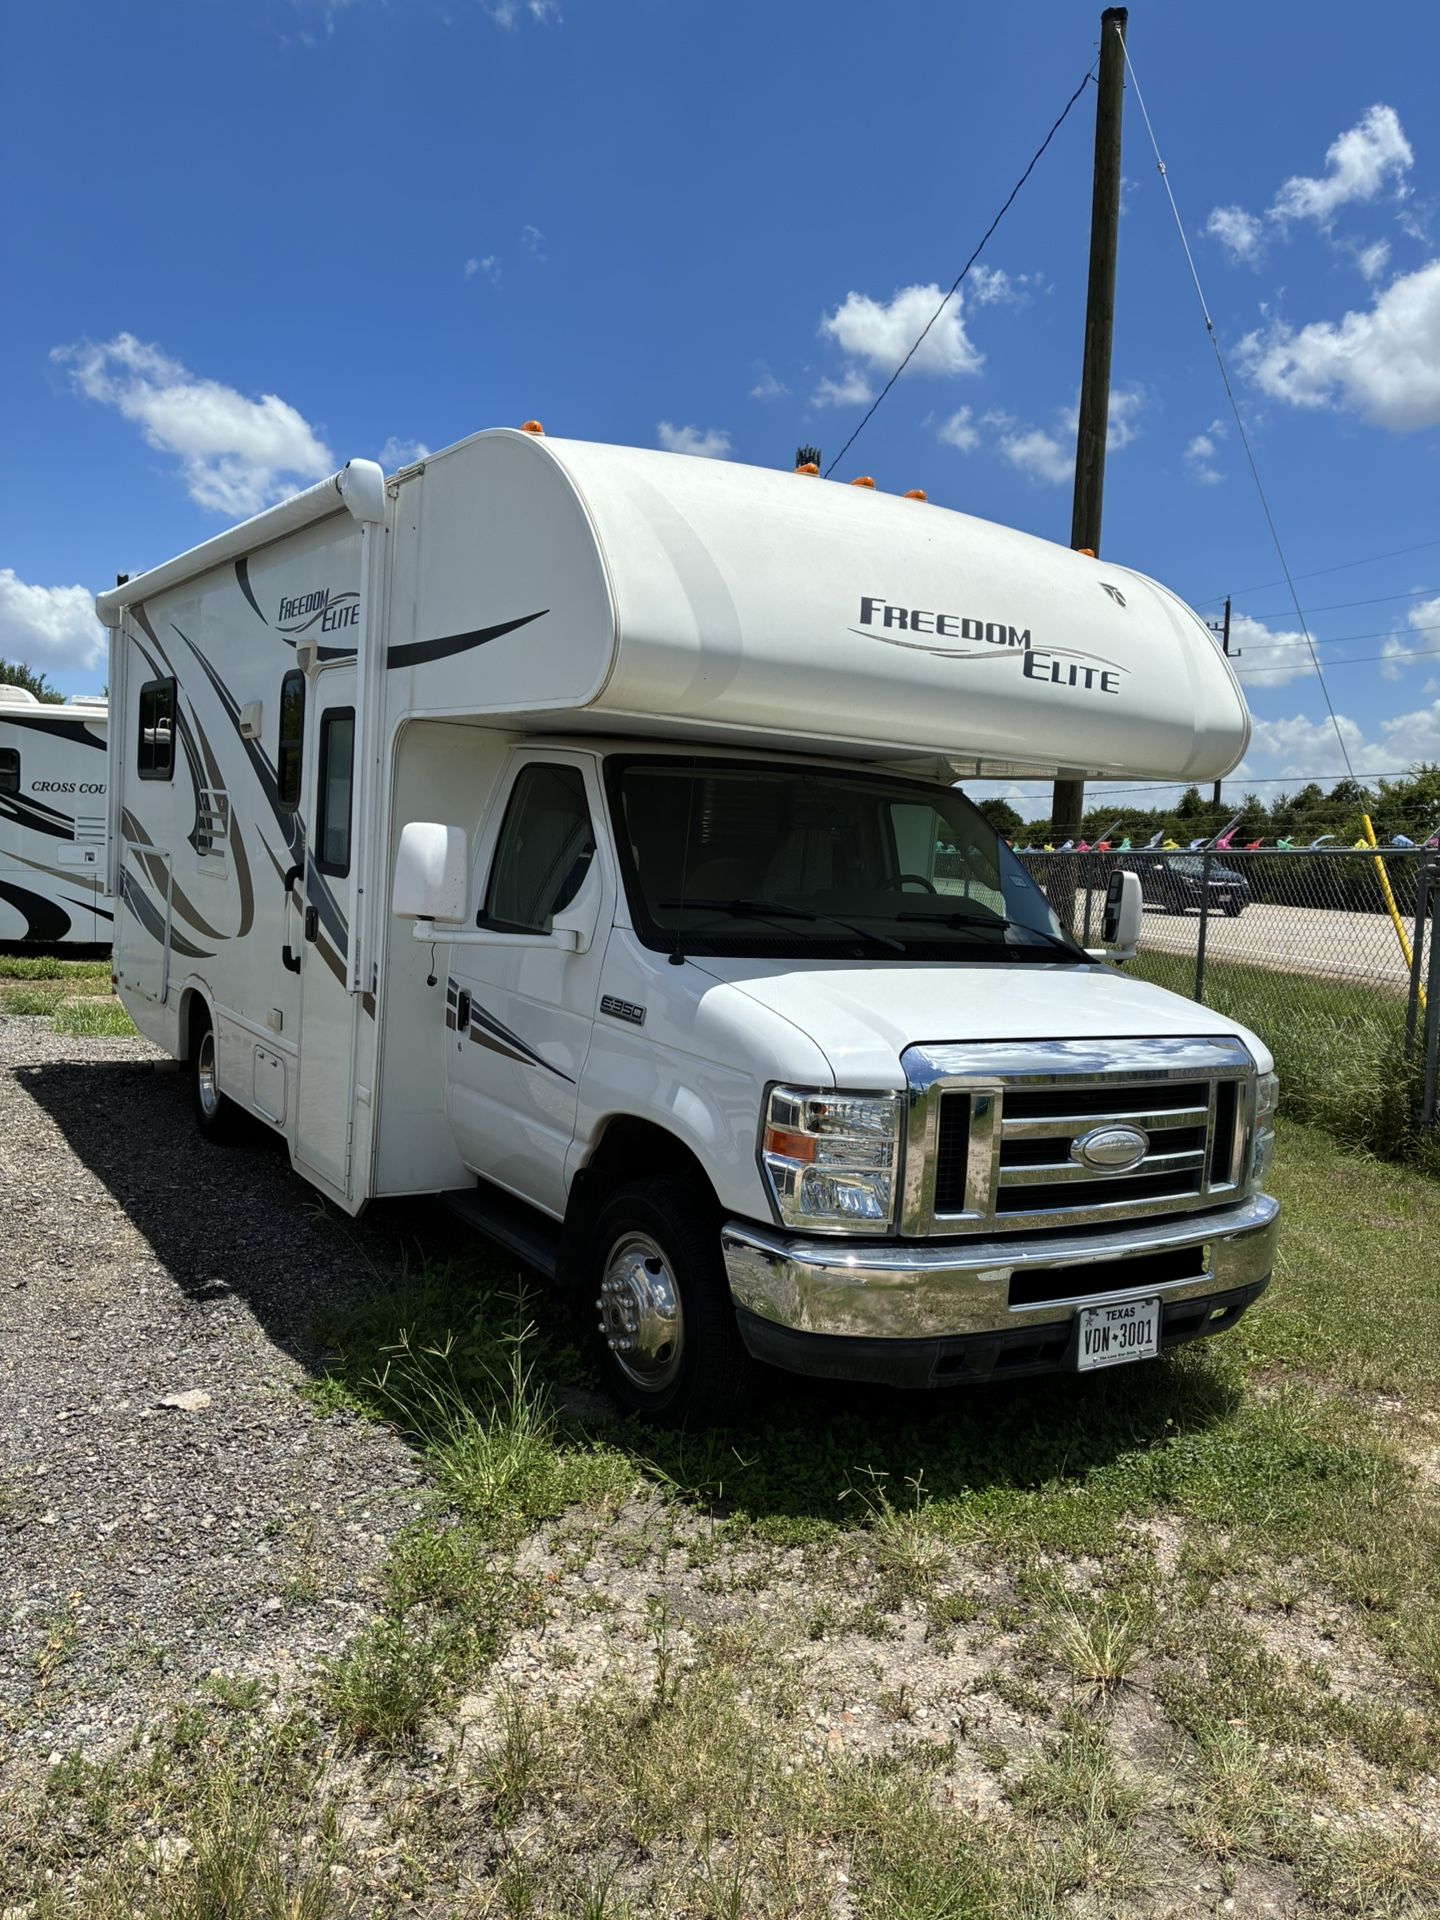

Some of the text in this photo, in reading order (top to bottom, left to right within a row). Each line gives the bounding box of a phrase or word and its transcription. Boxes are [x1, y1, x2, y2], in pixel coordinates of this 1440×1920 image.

[279, 587, 330, 622] FREEDOM
[321, 603, 360, 633] ELITE
[859, 596, 1031, 650] FREEDOM
[1022, 650, 1121, 695] ELITE
[31, 781, 77, 793] CROSS
[1105, 1306, 1136, 1321] TEXAS
[1120, 1319, 1153, 1348] 3001
